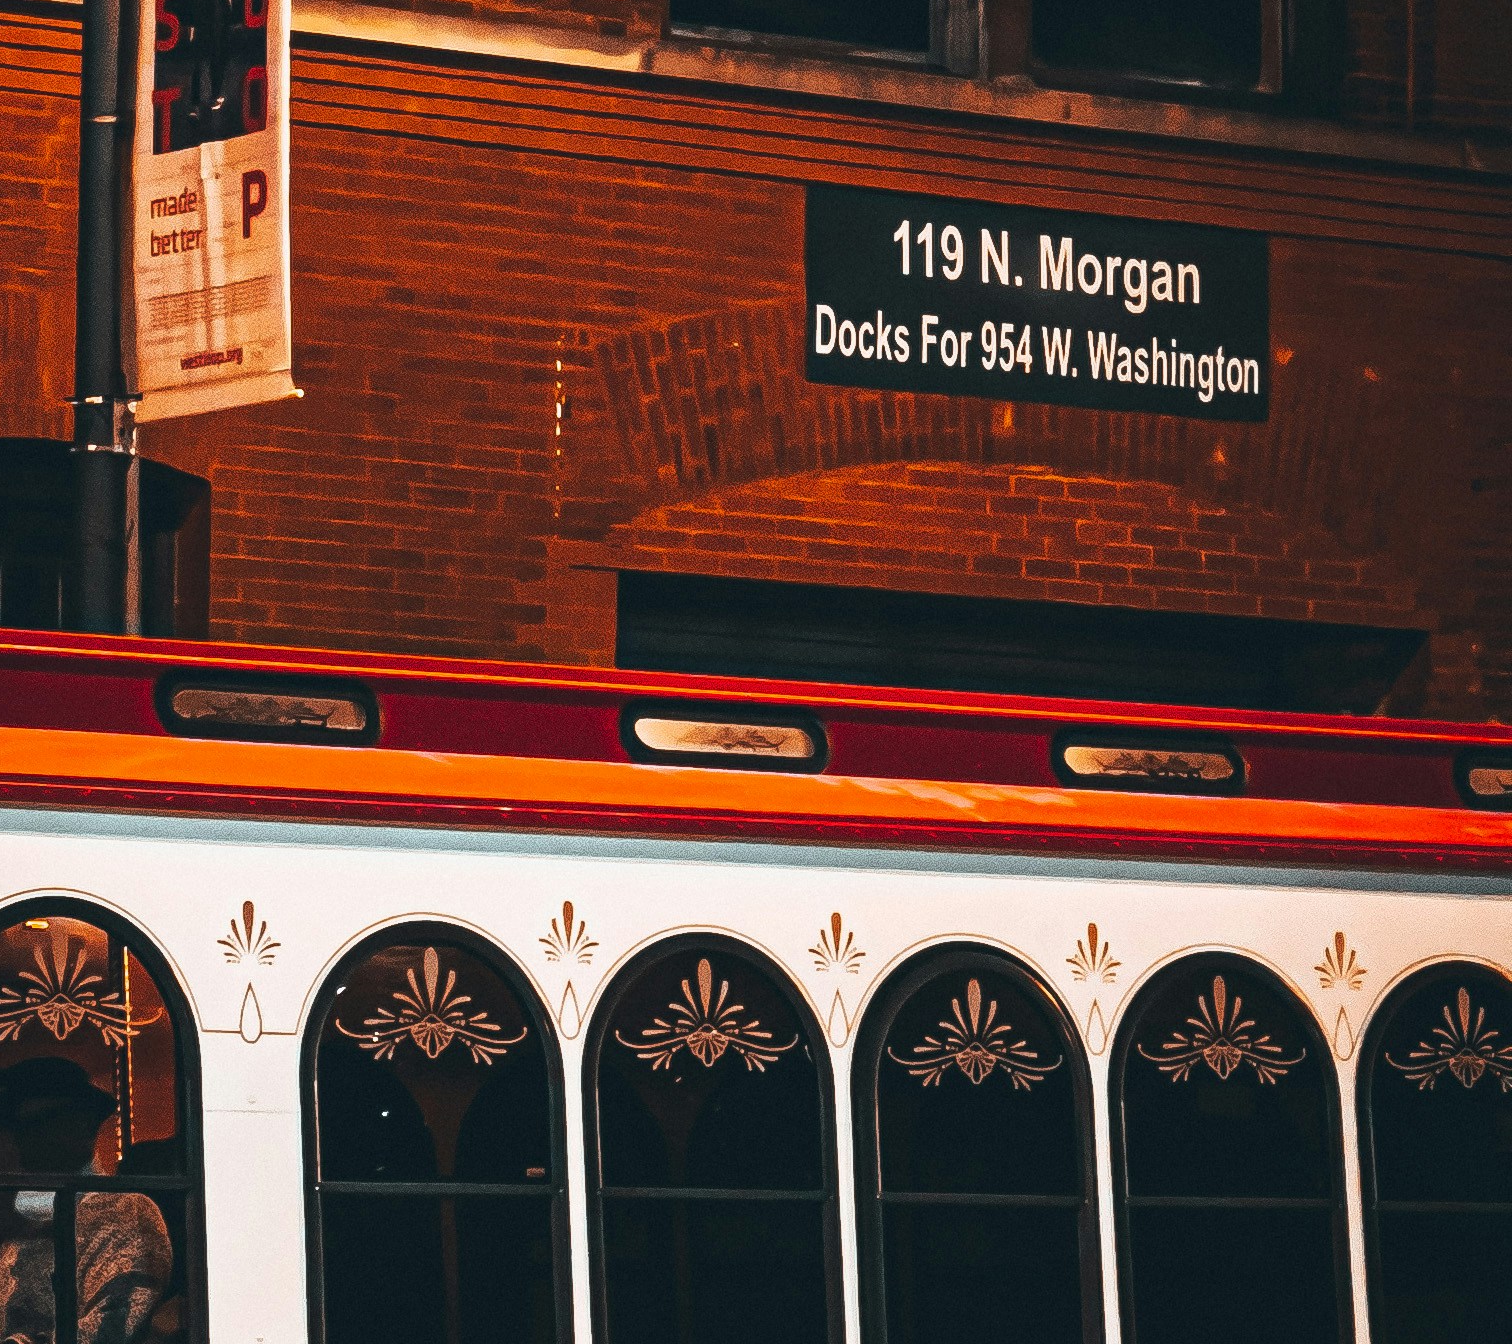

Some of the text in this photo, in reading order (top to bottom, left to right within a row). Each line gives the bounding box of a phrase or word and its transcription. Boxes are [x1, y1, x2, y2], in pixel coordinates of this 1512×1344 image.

[151, 186, 198, 219] made
[151, 228, 203, 257] better
[893, 220, 1201, 314] 119 N. Morgan
[815, 304, 1259, 403] Docks For 954 W. Washington
